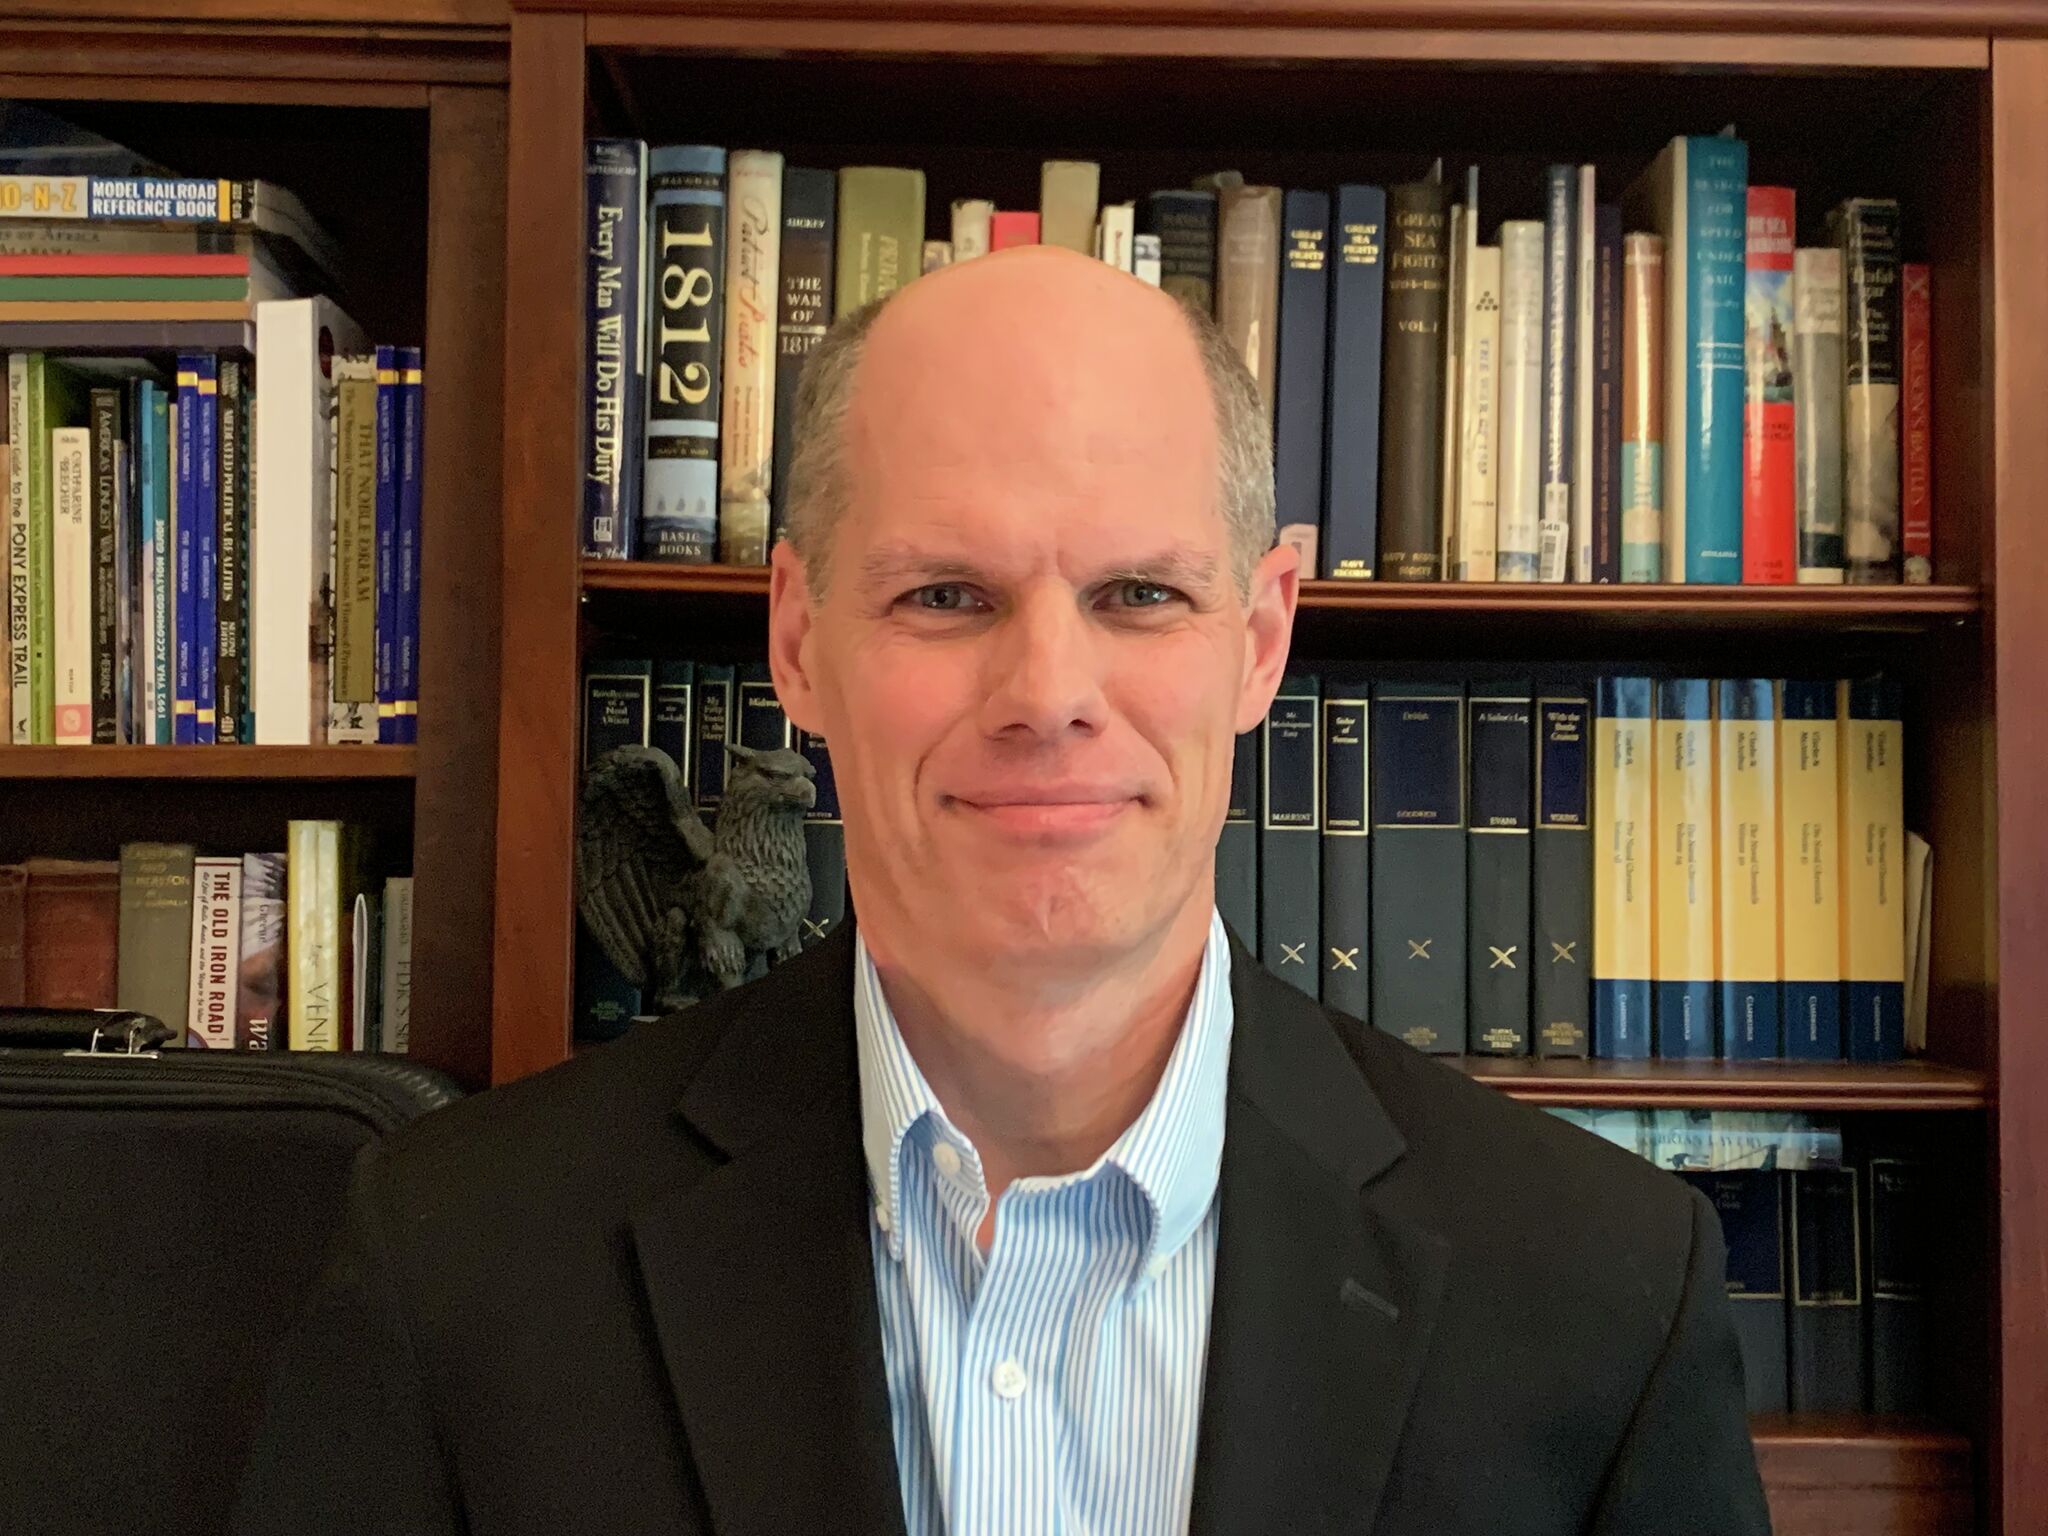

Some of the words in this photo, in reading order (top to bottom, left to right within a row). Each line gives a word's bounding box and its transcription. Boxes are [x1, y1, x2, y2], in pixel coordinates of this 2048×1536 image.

[93, 182, 140, 199] MODEL
[145, 183, 217, 200] RAILROAD
[93, 199, 171, 216] REFERENCE
[176, 200, 217, 217] BOOK
[588, 204, 624, 260] Every
[1404, 230, 1436, 249] SEA
[596, 264, 623, 308] Man
[786, 276, 822, 291] THE
[658, 221, 713, 406] 1812
[786, 293, 822, 308] WAR
[790, 310, 815, 323] OF
[596, 314, 622, 355] Will
[596, 361, 621, 393] Do
[595, 395, 620, 432] His
[359, 423, 372, 469] THAT
[587, 433, 619, 486] Duty
[12, 482, 22, 495] to
[358, 476, 372, 533] NOBLE
[12, 498, 23, 518] the
[12, 523, 27, 569] PONY
[99, 534, 113, 564] WAR
[155, 519, 166, 553] GUIDE
[659, 545, 703, 556] BOOKS
[660, 530, 702, 543] BASIC
[357, 538, 371, 602] DREAM
[12, 575, 28, 641] EXPRESS
[13, 645, 29, 689] TRAIL
[155, 663, 166, 690] YHA
[212, 871, 231, 902] THE
[211, 908, 228, 938] OLD
[209, 946, 227, 983] IRON
[207, 991, 224, 1033] ROAD
